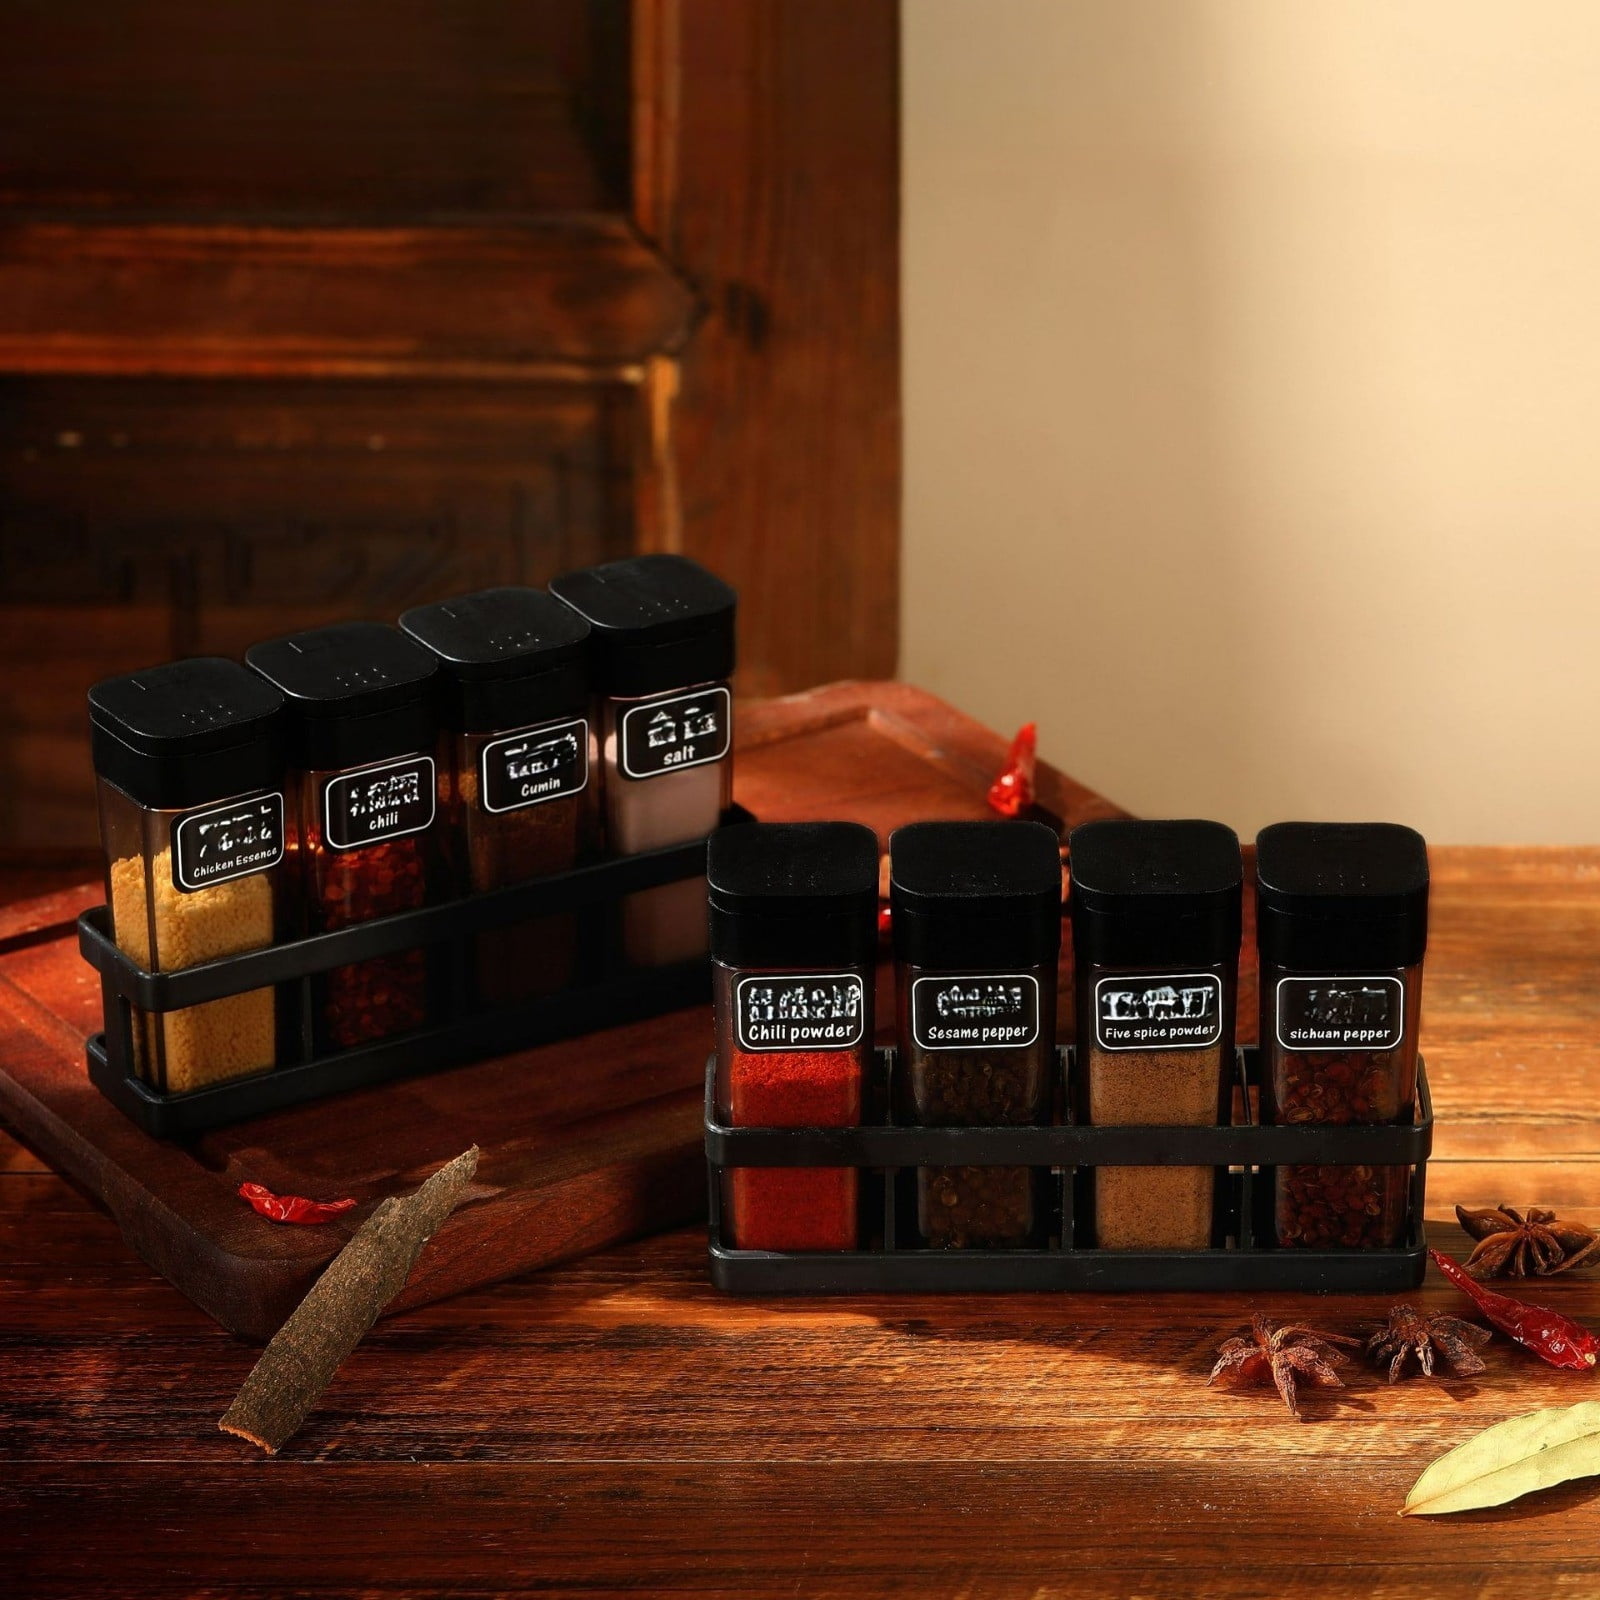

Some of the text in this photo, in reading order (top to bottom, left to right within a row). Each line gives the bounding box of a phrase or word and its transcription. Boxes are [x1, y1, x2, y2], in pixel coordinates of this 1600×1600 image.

[663, 745, 696, 765] salt
[521, 778, 561, 797] Cumin
[369, 811, 398, 830] chili
[193, 847, 277, 878] Chicken Essence
[748, 1023, 854, 1043] Chili powder
[928, 1026, 1028, 1041] Sesame pepper
[1105, 1025, 1215, 1040] Five spice powder
[1289, 1028, 1391, 1041] sichuan pepper
